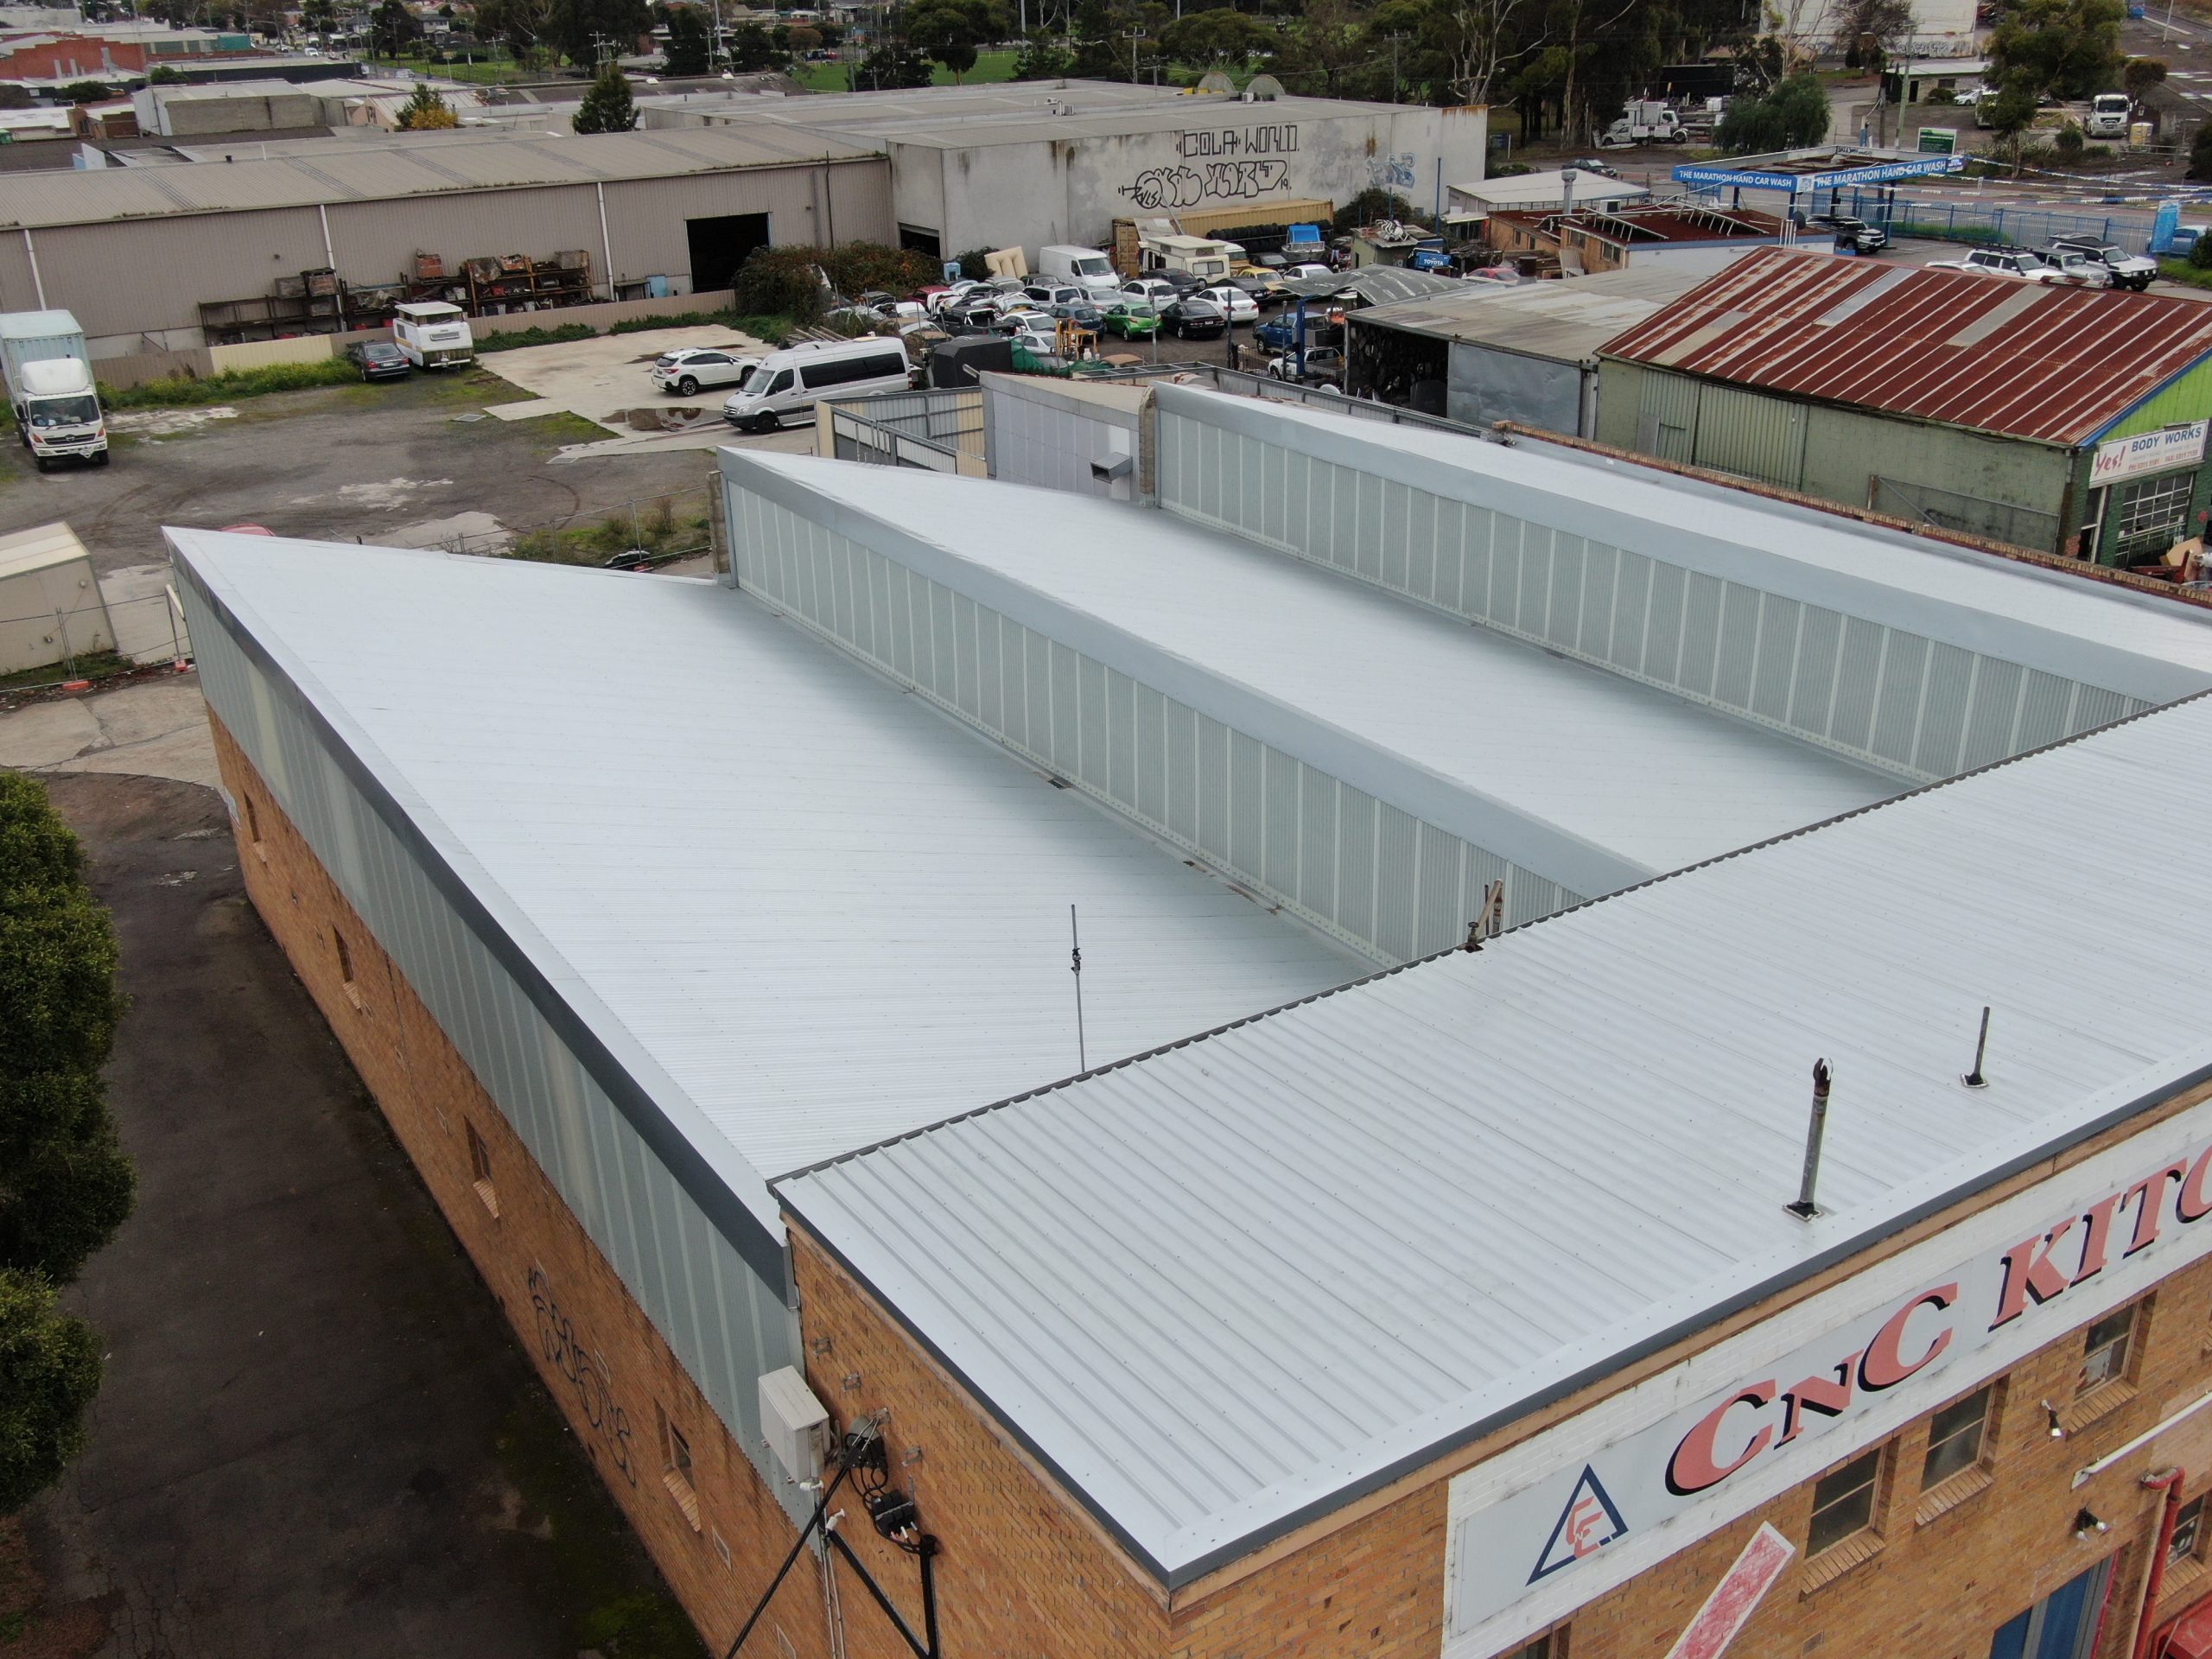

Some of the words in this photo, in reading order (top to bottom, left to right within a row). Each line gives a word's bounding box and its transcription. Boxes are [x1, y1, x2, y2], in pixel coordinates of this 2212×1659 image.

[1679, 170, 1693, 179] THE
[1694, 171, 1733, 181] MARATHON
[1732, 175, 1754, 184] HAND
[1754, 176, 1770, 186] CAR
[1770, 178, 1793, 188] WASH
[1817, 175, 1833, 188] THE
[1834, 168, 1881, 185] MARATHON
[1881, 166, 1904, 178] HAND
[1905, 163, 1923, 175] CAR
[1923, 161, 1946, 173] WASH
[2132, 435, 2161, 453] BODY
[2165, 427, 2202, 444] WORKS
